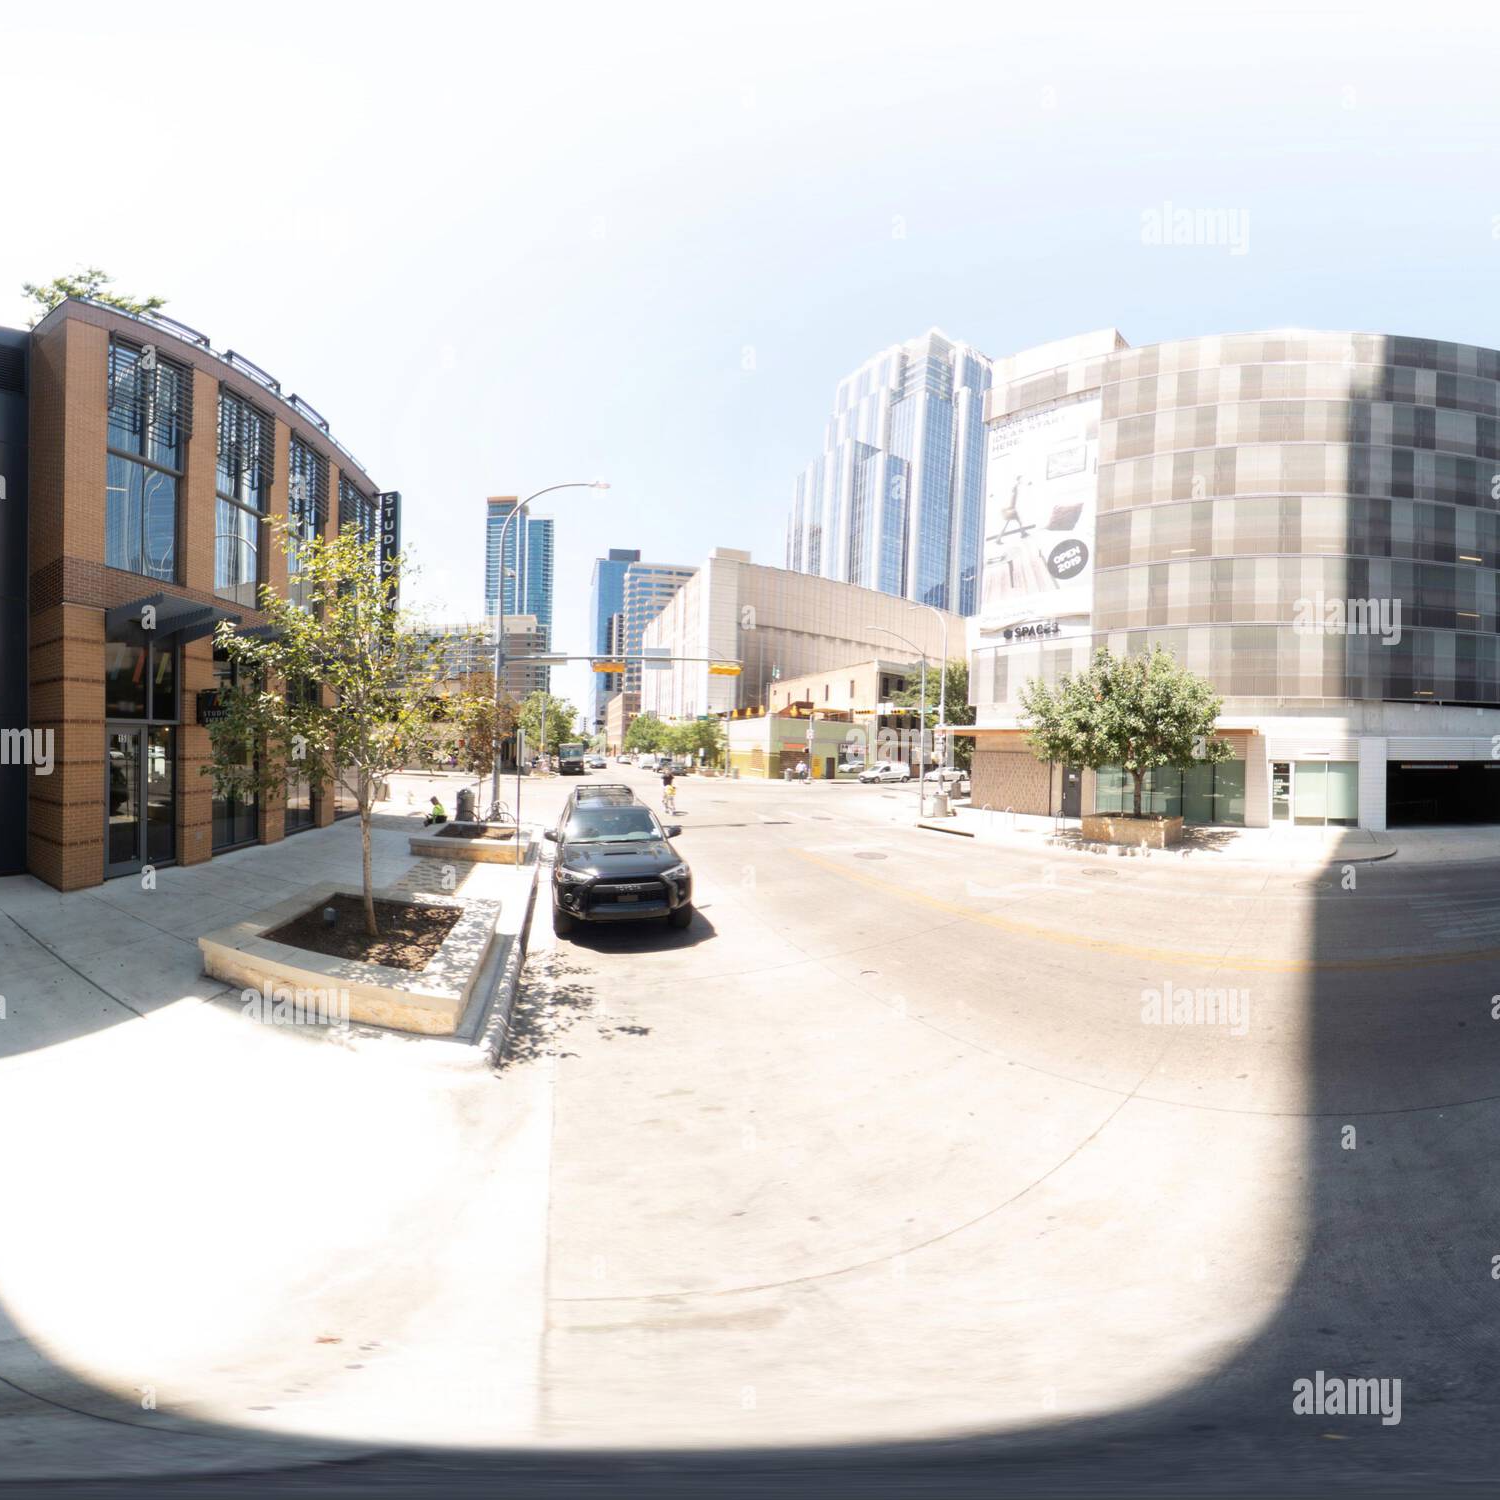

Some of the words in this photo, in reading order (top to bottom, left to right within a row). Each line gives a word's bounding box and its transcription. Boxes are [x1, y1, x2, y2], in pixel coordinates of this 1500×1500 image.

[382, 494, 395, 573] STUDIO
[1053, 546, 1081, 564] OPEN
[1057, 556, 1082, 573] 2019
[1015, 623, 1060, 638] SPACES
